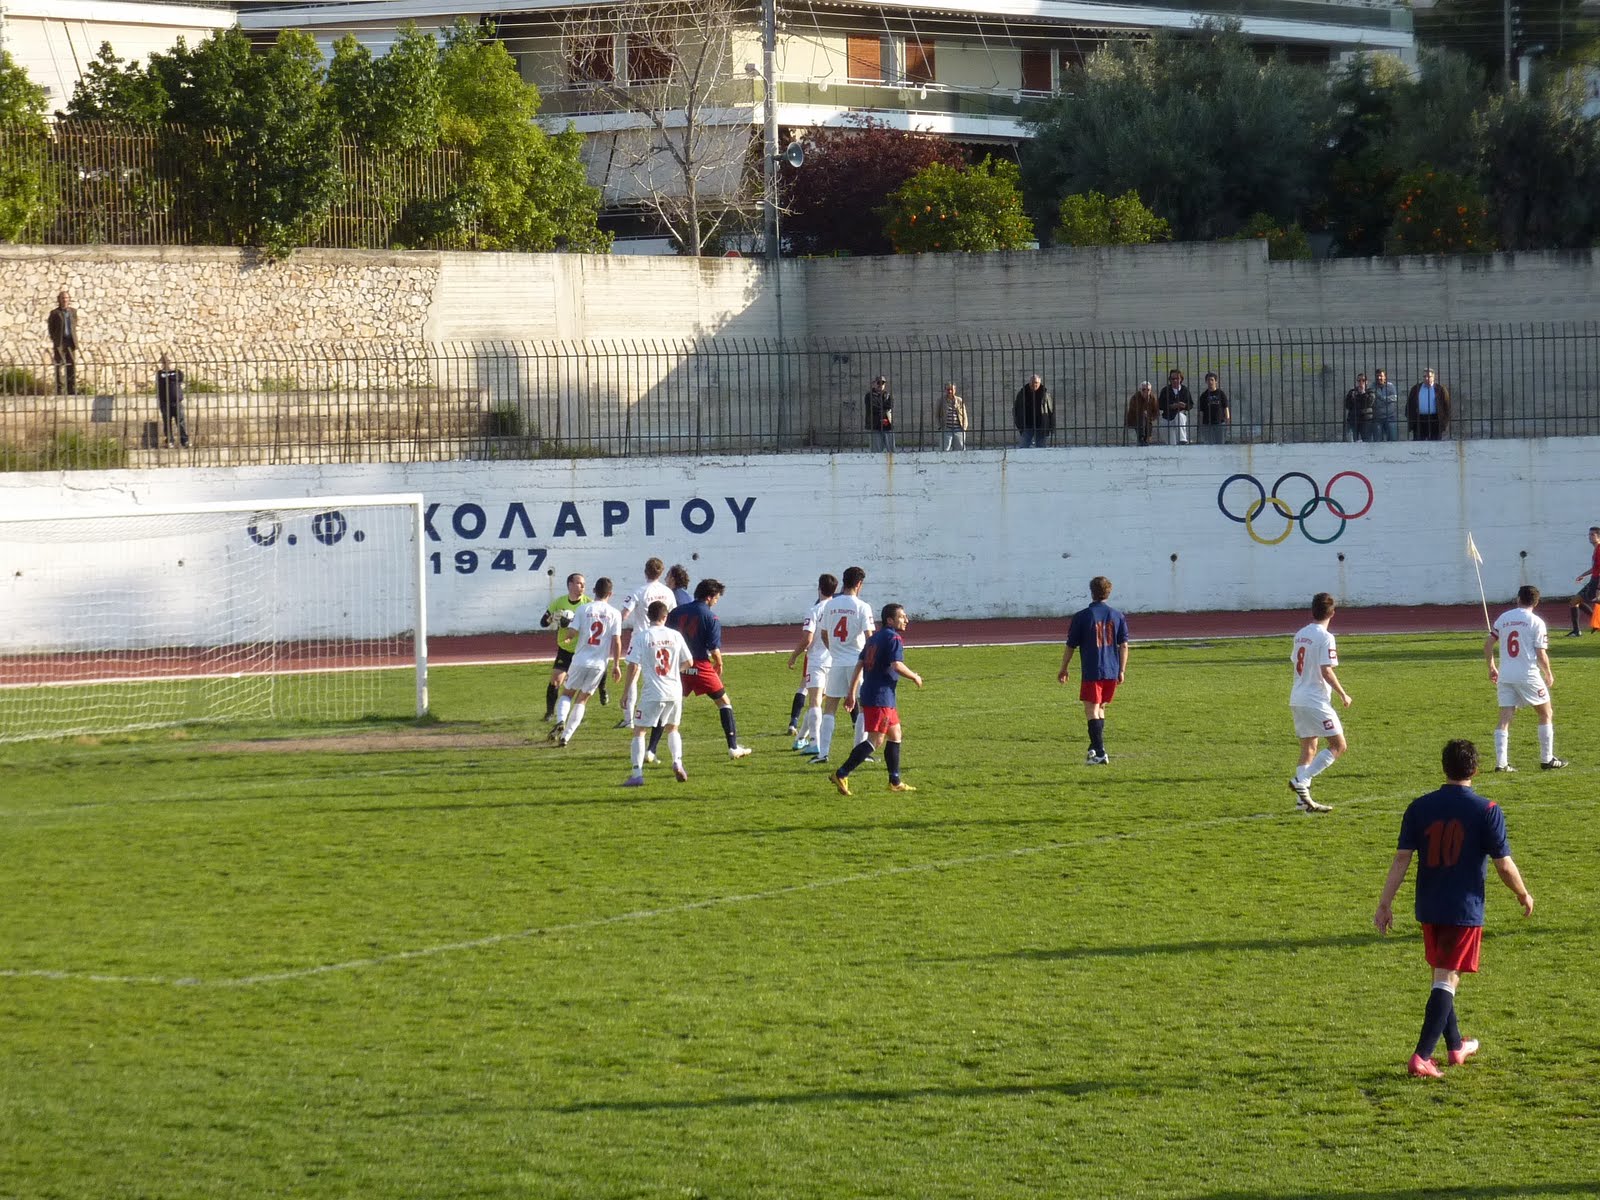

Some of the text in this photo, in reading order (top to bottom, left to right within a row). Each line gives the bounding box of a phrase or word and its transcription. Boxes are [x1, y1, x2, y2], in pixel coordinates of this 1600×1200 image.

[429, 548, 548, 575] 1947
[587, 620, 604, 646] 2
[833, 615, 849, 643] 4
[1507, 630, 1520, 658] 6
[655, 647, 670, 676] 3
[1424, 818, 1465, 868] 10
